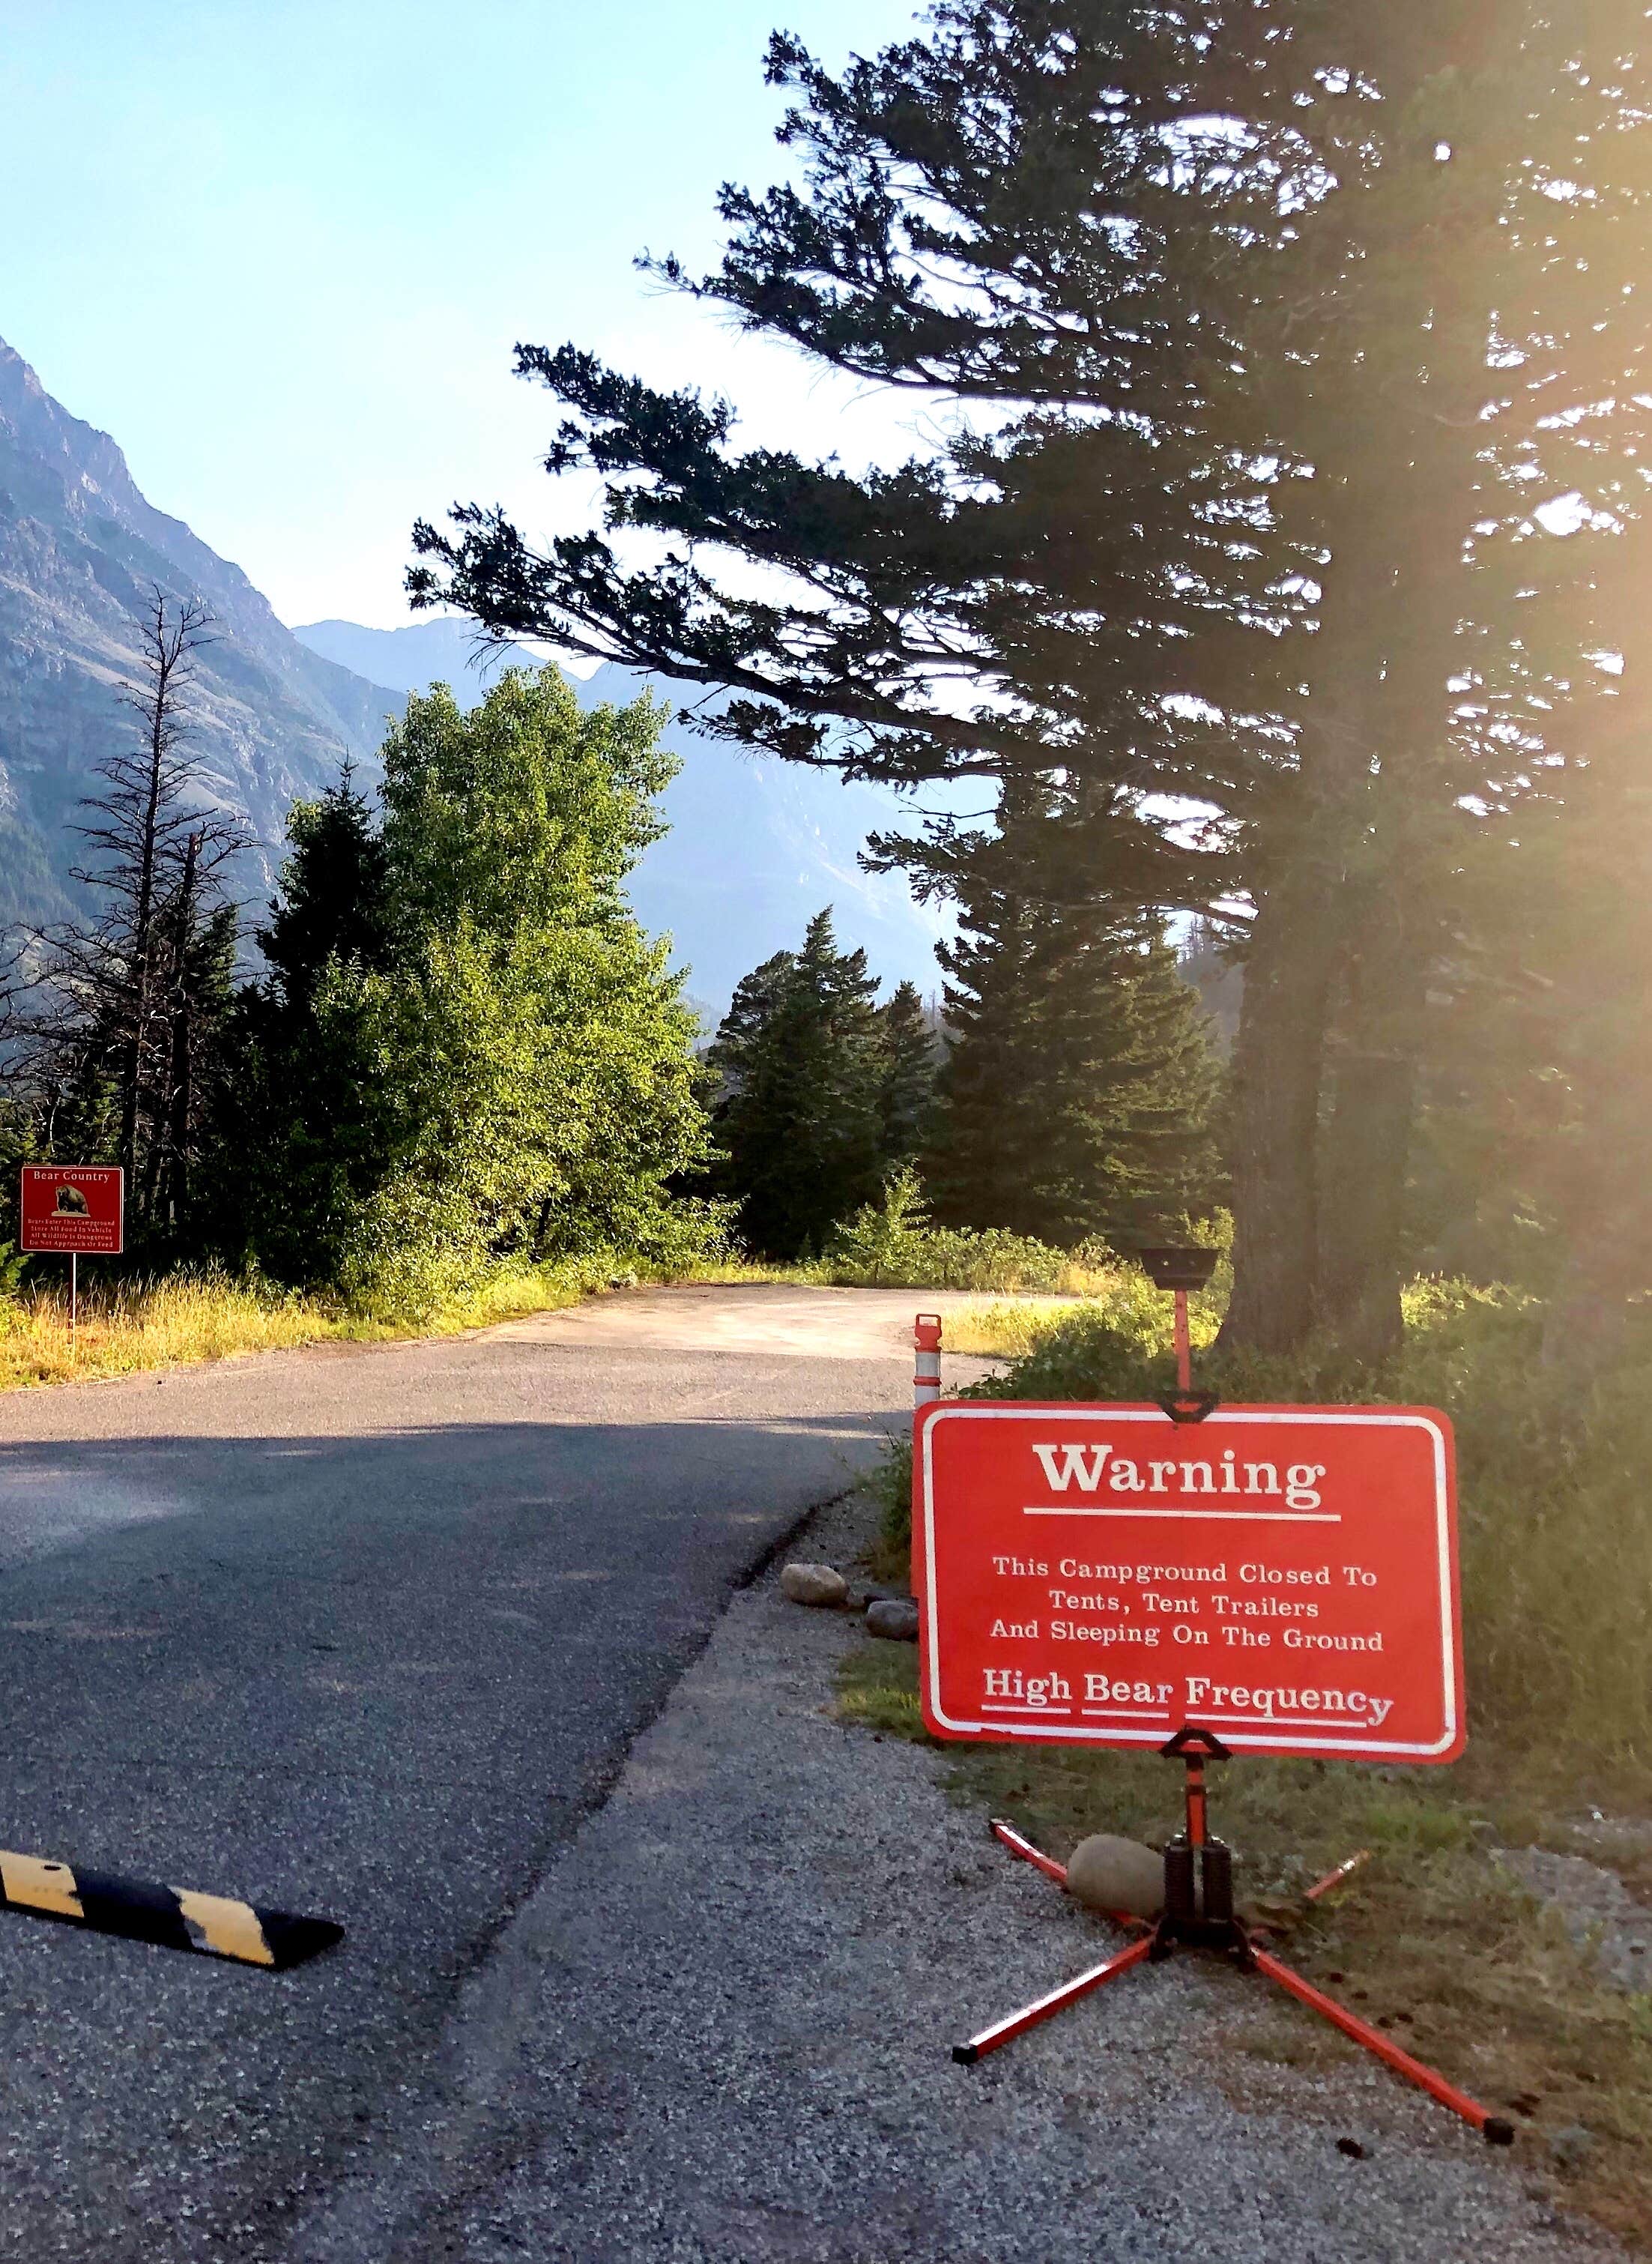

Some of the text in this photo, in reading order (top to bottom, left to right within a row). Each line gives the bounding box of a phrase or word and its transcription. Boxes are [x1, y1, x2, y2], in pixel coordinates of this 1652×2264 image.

[34, 1171, 109, 1183] Bear Country
[1032, 1443, 1327, 1509] Warning
[993, 1557, 1378, 1587] This Campground Closed To
[1050, 1590, 1319, 1617] Tents, Tent Trailers
[990, 1619, 1384, 1652] And Sleeping On The Ground
[983, 1669, 1394, 1725] High Bear Frequency
